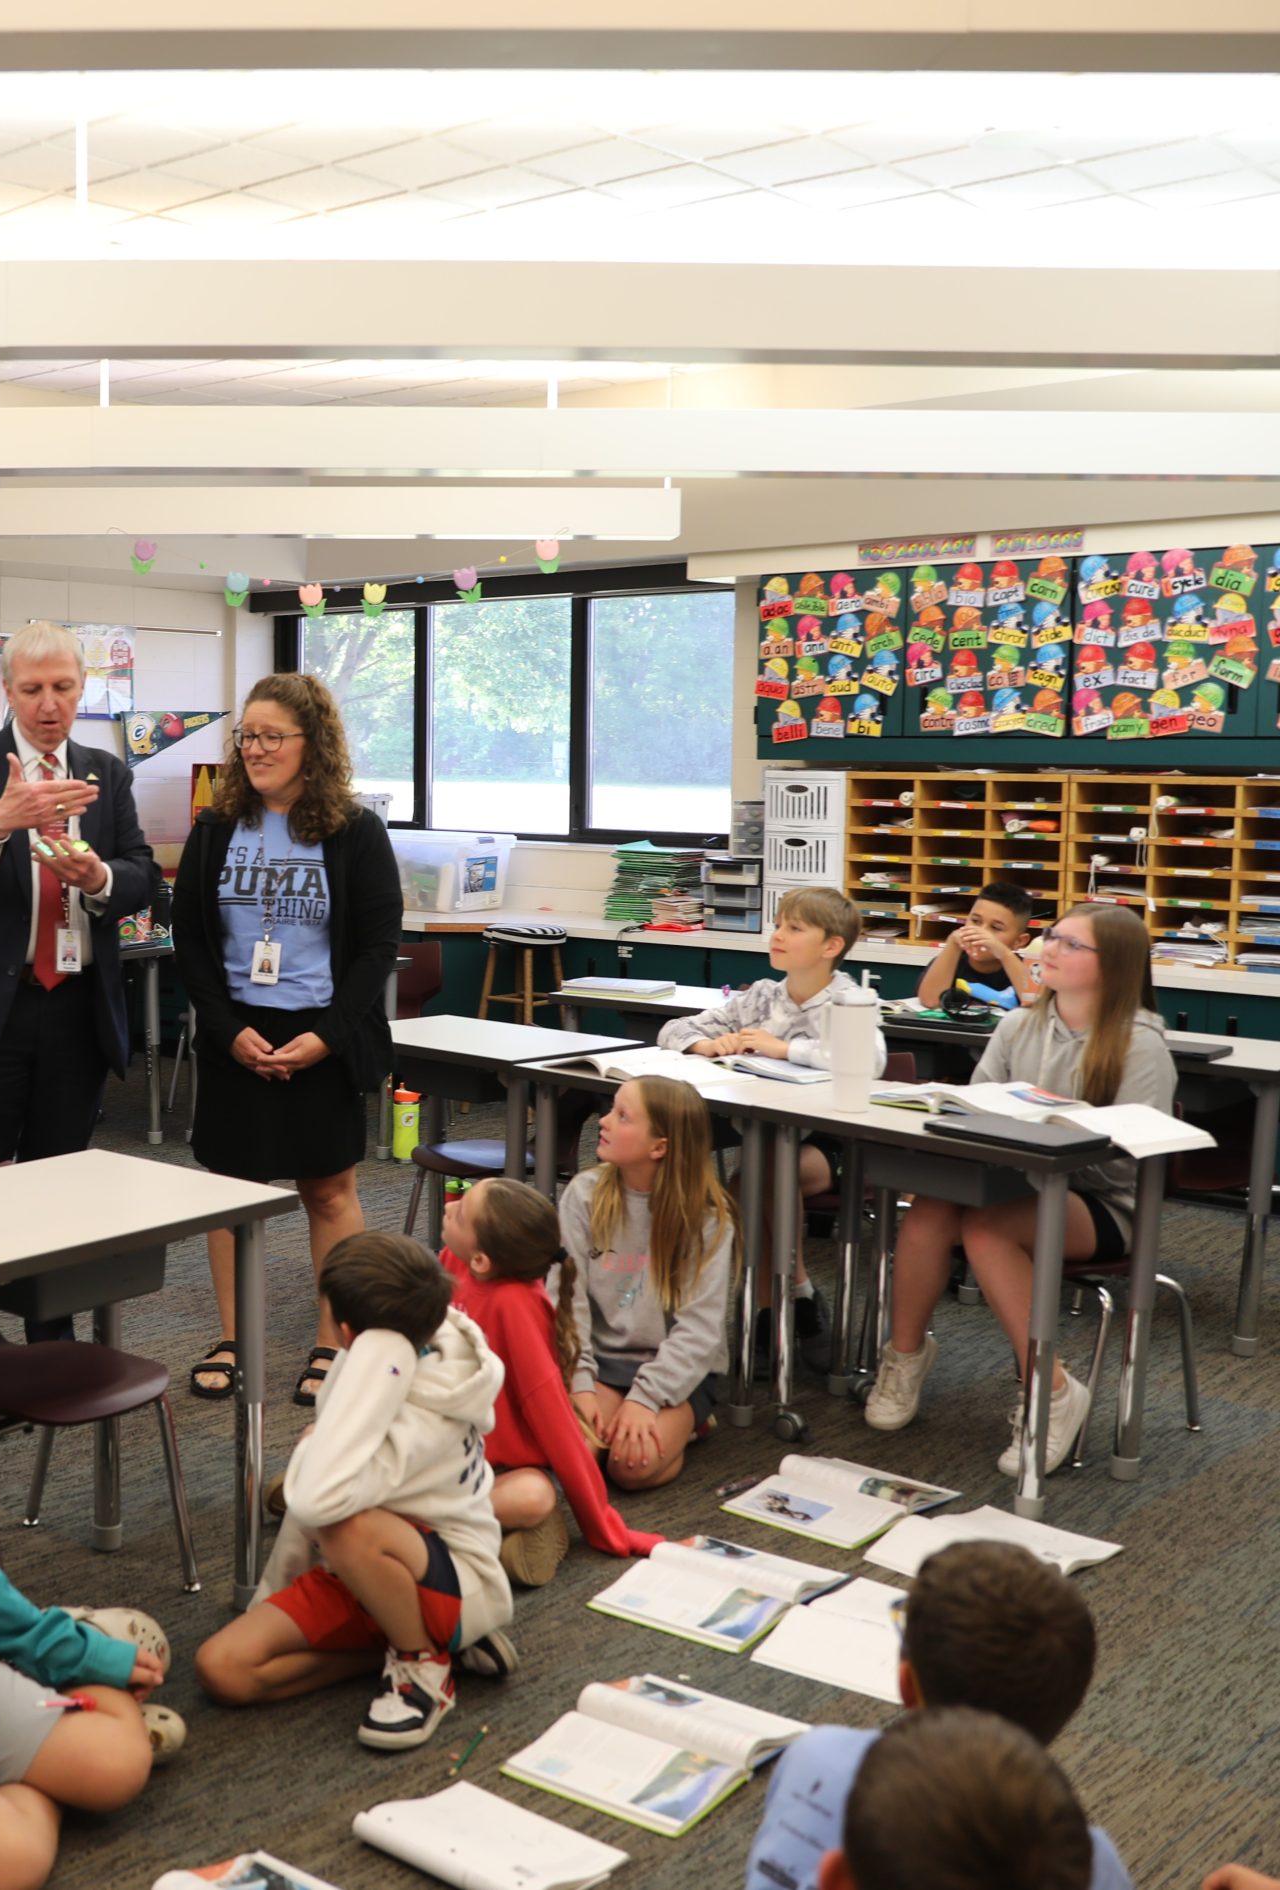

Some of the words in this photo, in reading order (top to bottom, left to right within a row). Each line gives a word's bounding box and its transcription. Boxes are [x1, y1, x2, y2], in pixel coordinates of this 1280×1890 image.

[858, 538, 974, 561] VOCABULARY
[995, 532, 1083, 553] BUILDERS
[1171, 575, 1204, 594] cycle
[1215, 573, 1241, 591] dia
[992, 588, 1019, 603] capt
[1127, 583, 1154, 597] cure
[836, 599, 860, 610] aero
[864, 597, 889, 610] ambi
[954, 592, 976, 605] bio
[1038, 628, 1063, 643] cide
[1085, 631, 1109, 644] dict
[1142, 625, 1157, 639] de
[830, 639, 856, 654] anti
[870, 638, 895, 653] arch
[912, 632, 941, 650] cede
[951, 633, 982, 647] cent
[1121, 670, 1147, 685] fact
[1213, 658, 1243, 682] form
[867, 675, 894, 692] auto
[1032, 670, 1058, 687] cogn
[1171, 670, 1196, 686] fer
[759, 682, 784, 697] aqua
[793, 683, 817, 696] astr
[829, 682, 851, 694] aud
[857, 720, 871, 735] bi
[1026, 718, 1057, 733] cred
[1084, 713, 1113, 729] fract
[1151, 716, 1178, 730] gen
[1186, 712, 1217, 730] geo
[776, 727, 804, 741] belli
[815, 724, 841, 736] bene
[217, 866, 326, 900] PUMA
[261, 898, 326, 920] THING
